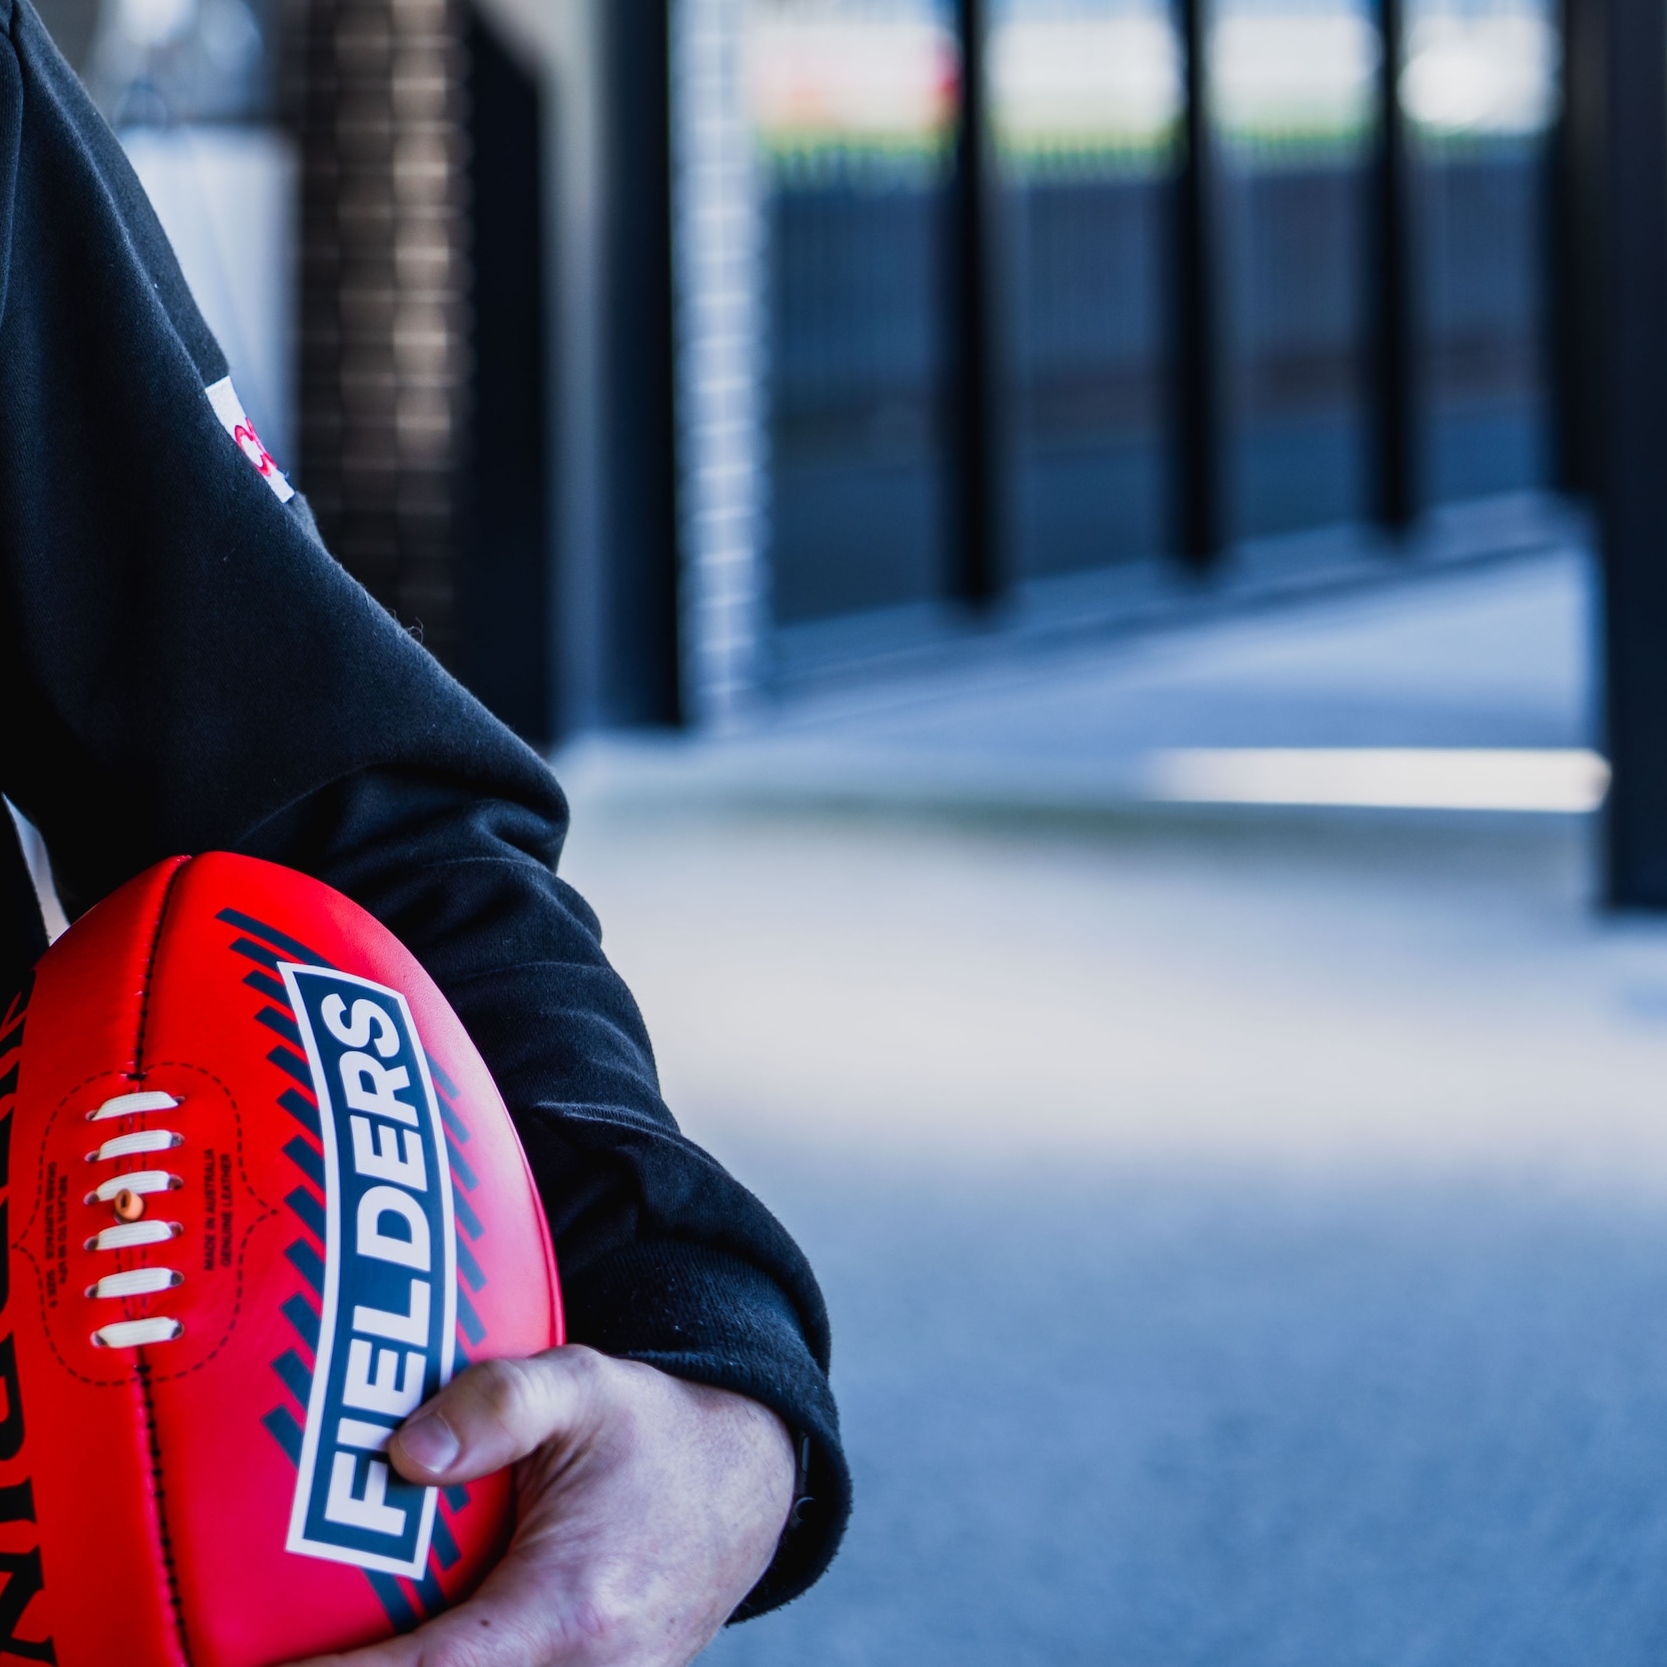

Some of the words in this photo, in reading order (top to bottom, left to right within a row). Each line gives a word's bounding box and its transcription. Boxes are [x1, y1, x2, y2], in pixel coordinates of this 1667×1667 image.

[203, 1148, 216, 1214] AUSTRALIA
[220, 1153, 233, 1207] LEATHER
[204, 1217, 216, 1230] IN
[220, 1211, 233, 1267] GENUINE
[203, 1234, 216, 1271] MADE
[320, 991, 432, 1537] FIELDERS
